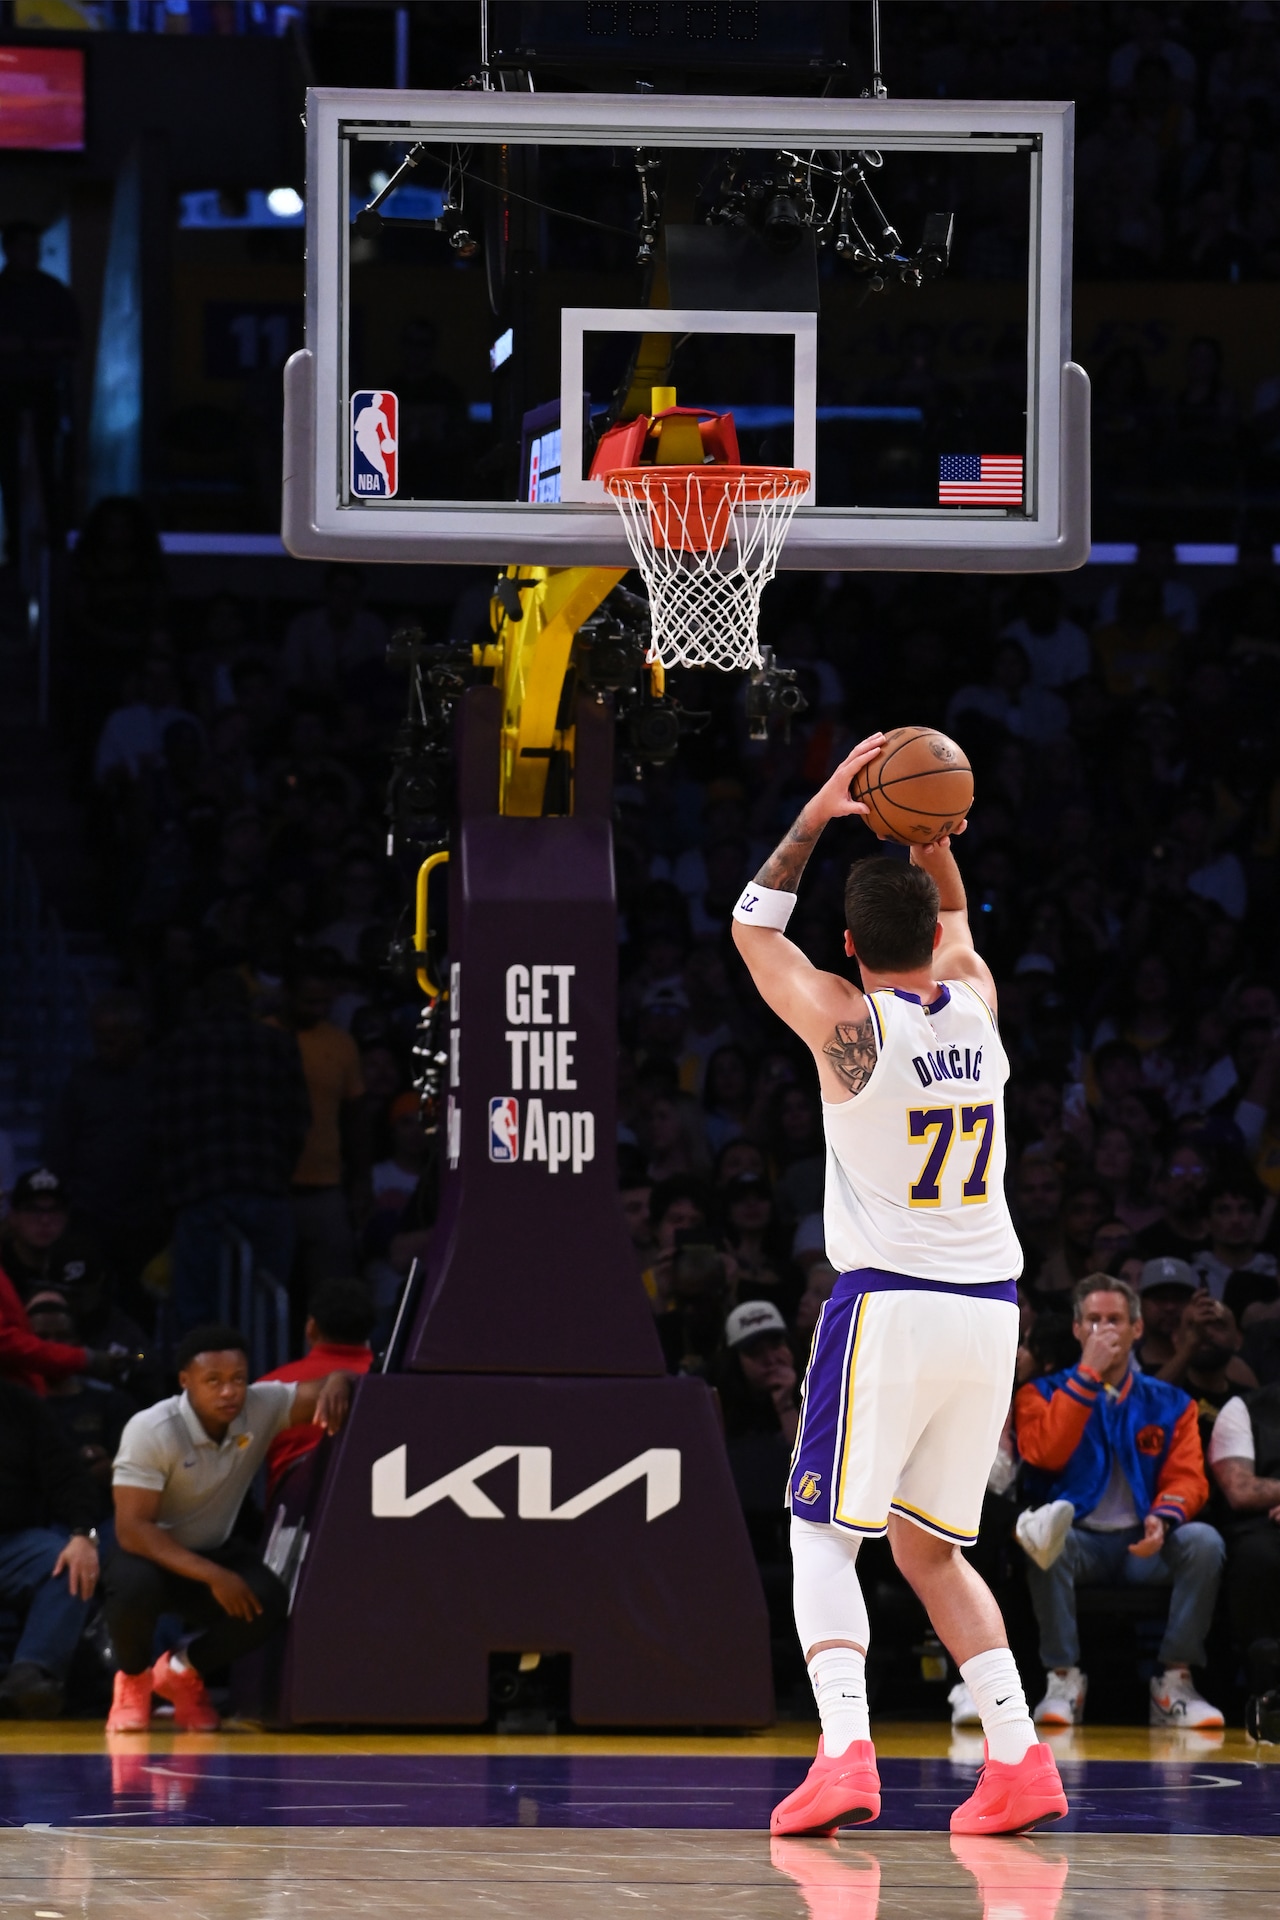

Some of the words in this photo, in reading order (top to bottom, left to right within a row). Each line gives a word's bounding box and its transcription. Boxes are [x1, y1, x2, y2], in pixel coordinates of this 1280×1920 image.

[229, 313, 289, 368] 11
[358, 473, 381, 491] NBA
[505, 964, 576, 1025] GET
[505, 1030, 577, 1091] THE
[911, 1044, 983, 1088] DONČIĆ
[522, 1098, 595, 1174] App
[907, 1101, 995, 1208] 77
[371, 1444, 682, 1522] KIA
